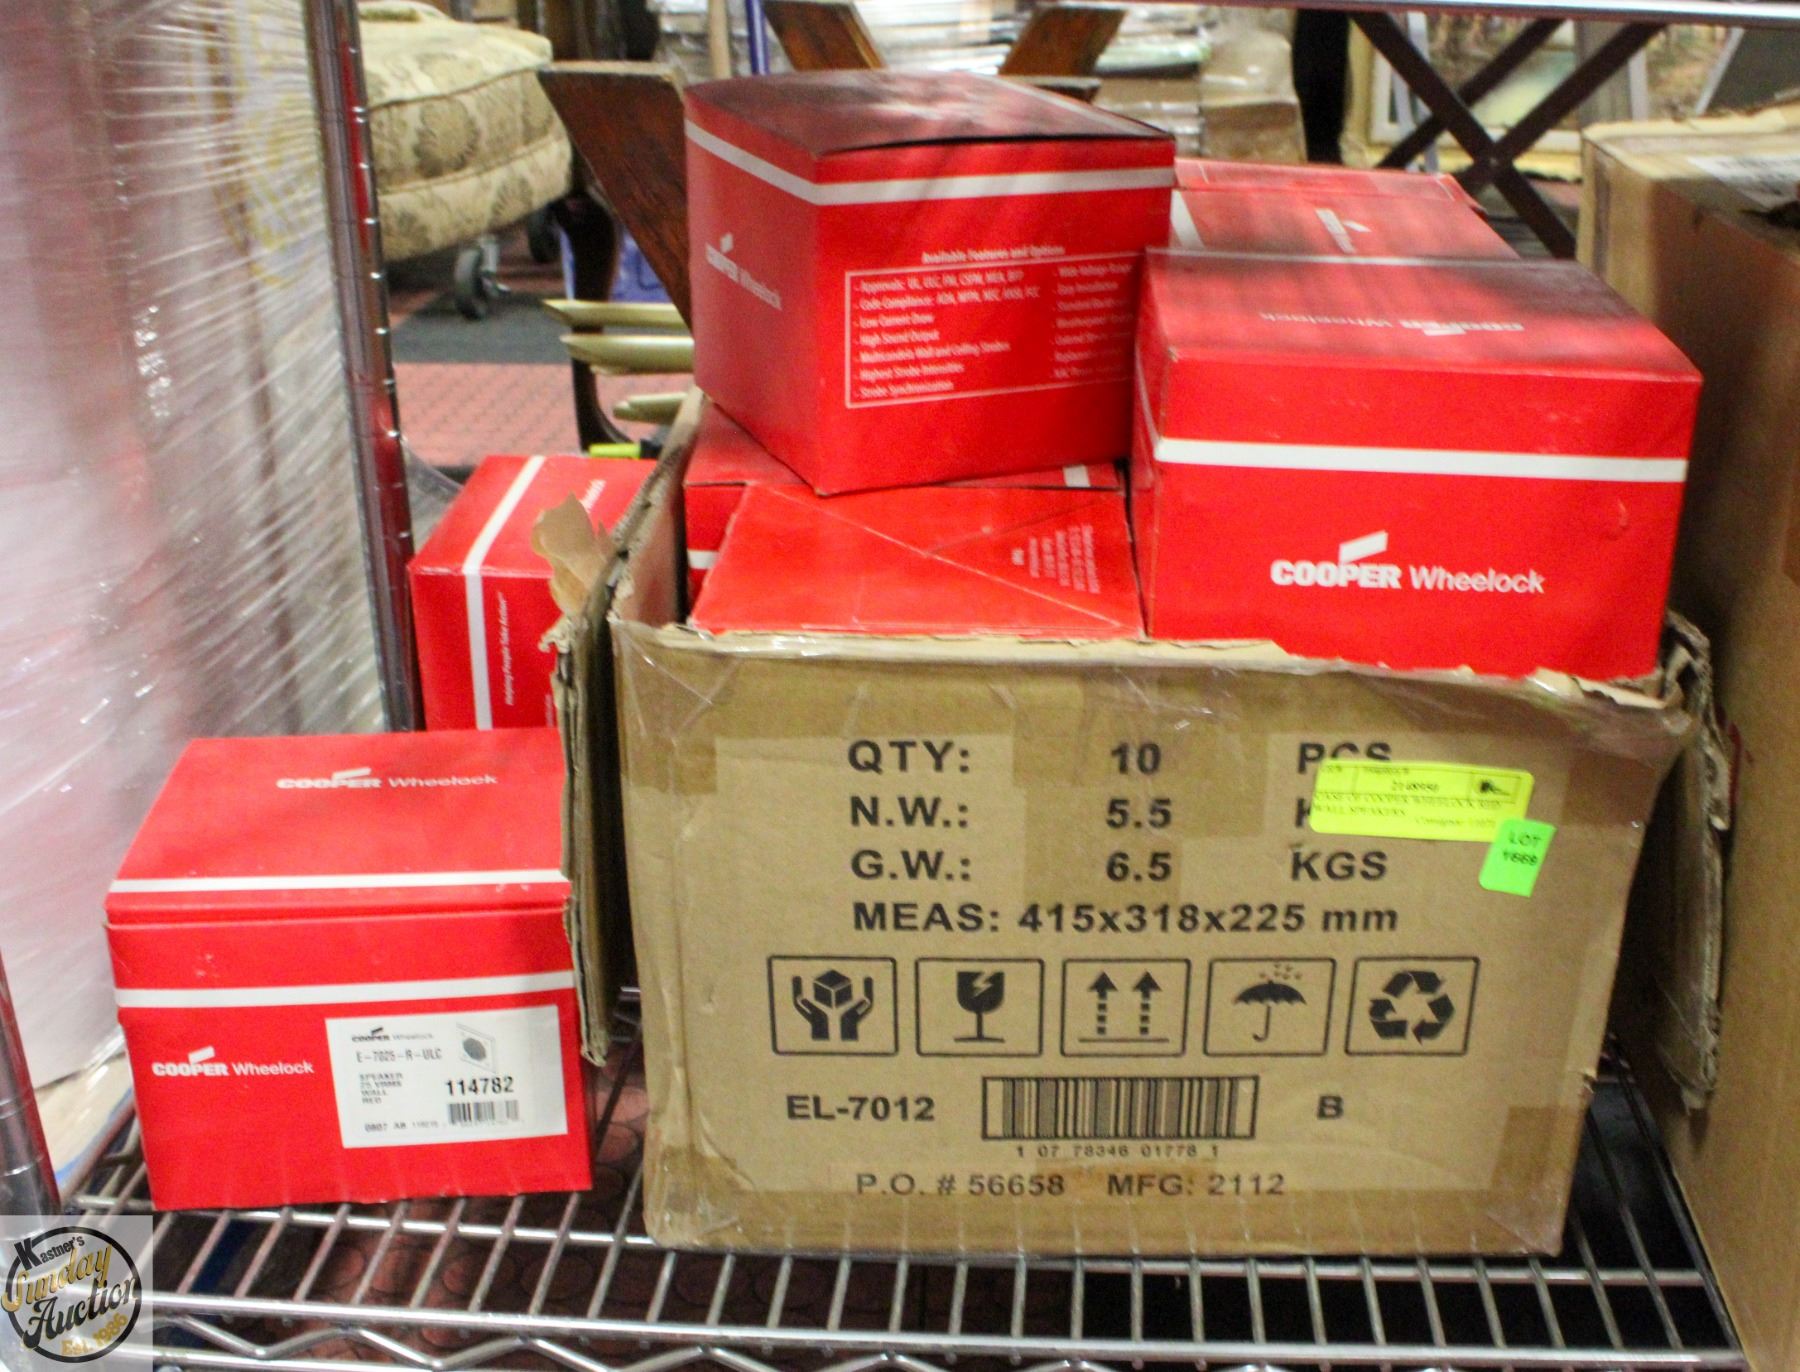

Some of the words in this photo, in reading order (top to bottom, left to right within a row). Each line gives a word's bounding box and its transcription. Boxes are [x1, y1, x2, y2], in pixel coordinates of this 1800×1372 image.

[1270, 559, 1402, 589] COOPER
[1409, 565, 1546, 593] Wheelock
[848, 739, 969, 775] QTY:
[1111, 742, 1161, 774] 10
[276, 777, 382, 789] COOPER
[388, 774, 498, 788] Wheelock
[850, 796, 968, 829] N.W.:
[1106, 797, 1172, 829] 5.5
[1508, 832, 1541, 847] LOT
[851, 849, 971, 881] G.W.:
[1106, 851, 1172, 882] 6.5
[1291, 851, 1389, 882] KGS
[853, 902, 1000, 932] MEAS:
[1018, 903, 1305, 933] 415x318x225
[1322, 908, 1398, 933] mm
[152, 1062, 229, 1077] COOPER
[231, 1060, 314, 1075] Wheelock
[445, 1075, 514, 1096] 114782
[786, 1095, 935, 1121] EL-7012
[1317, 1094, 1344, 1120] B
[968, 1173, 1065, 1197] 56658
[1107, 1173, 1193, 1196] MFG:
[1208, 1172, 1285, 1196] 2112
